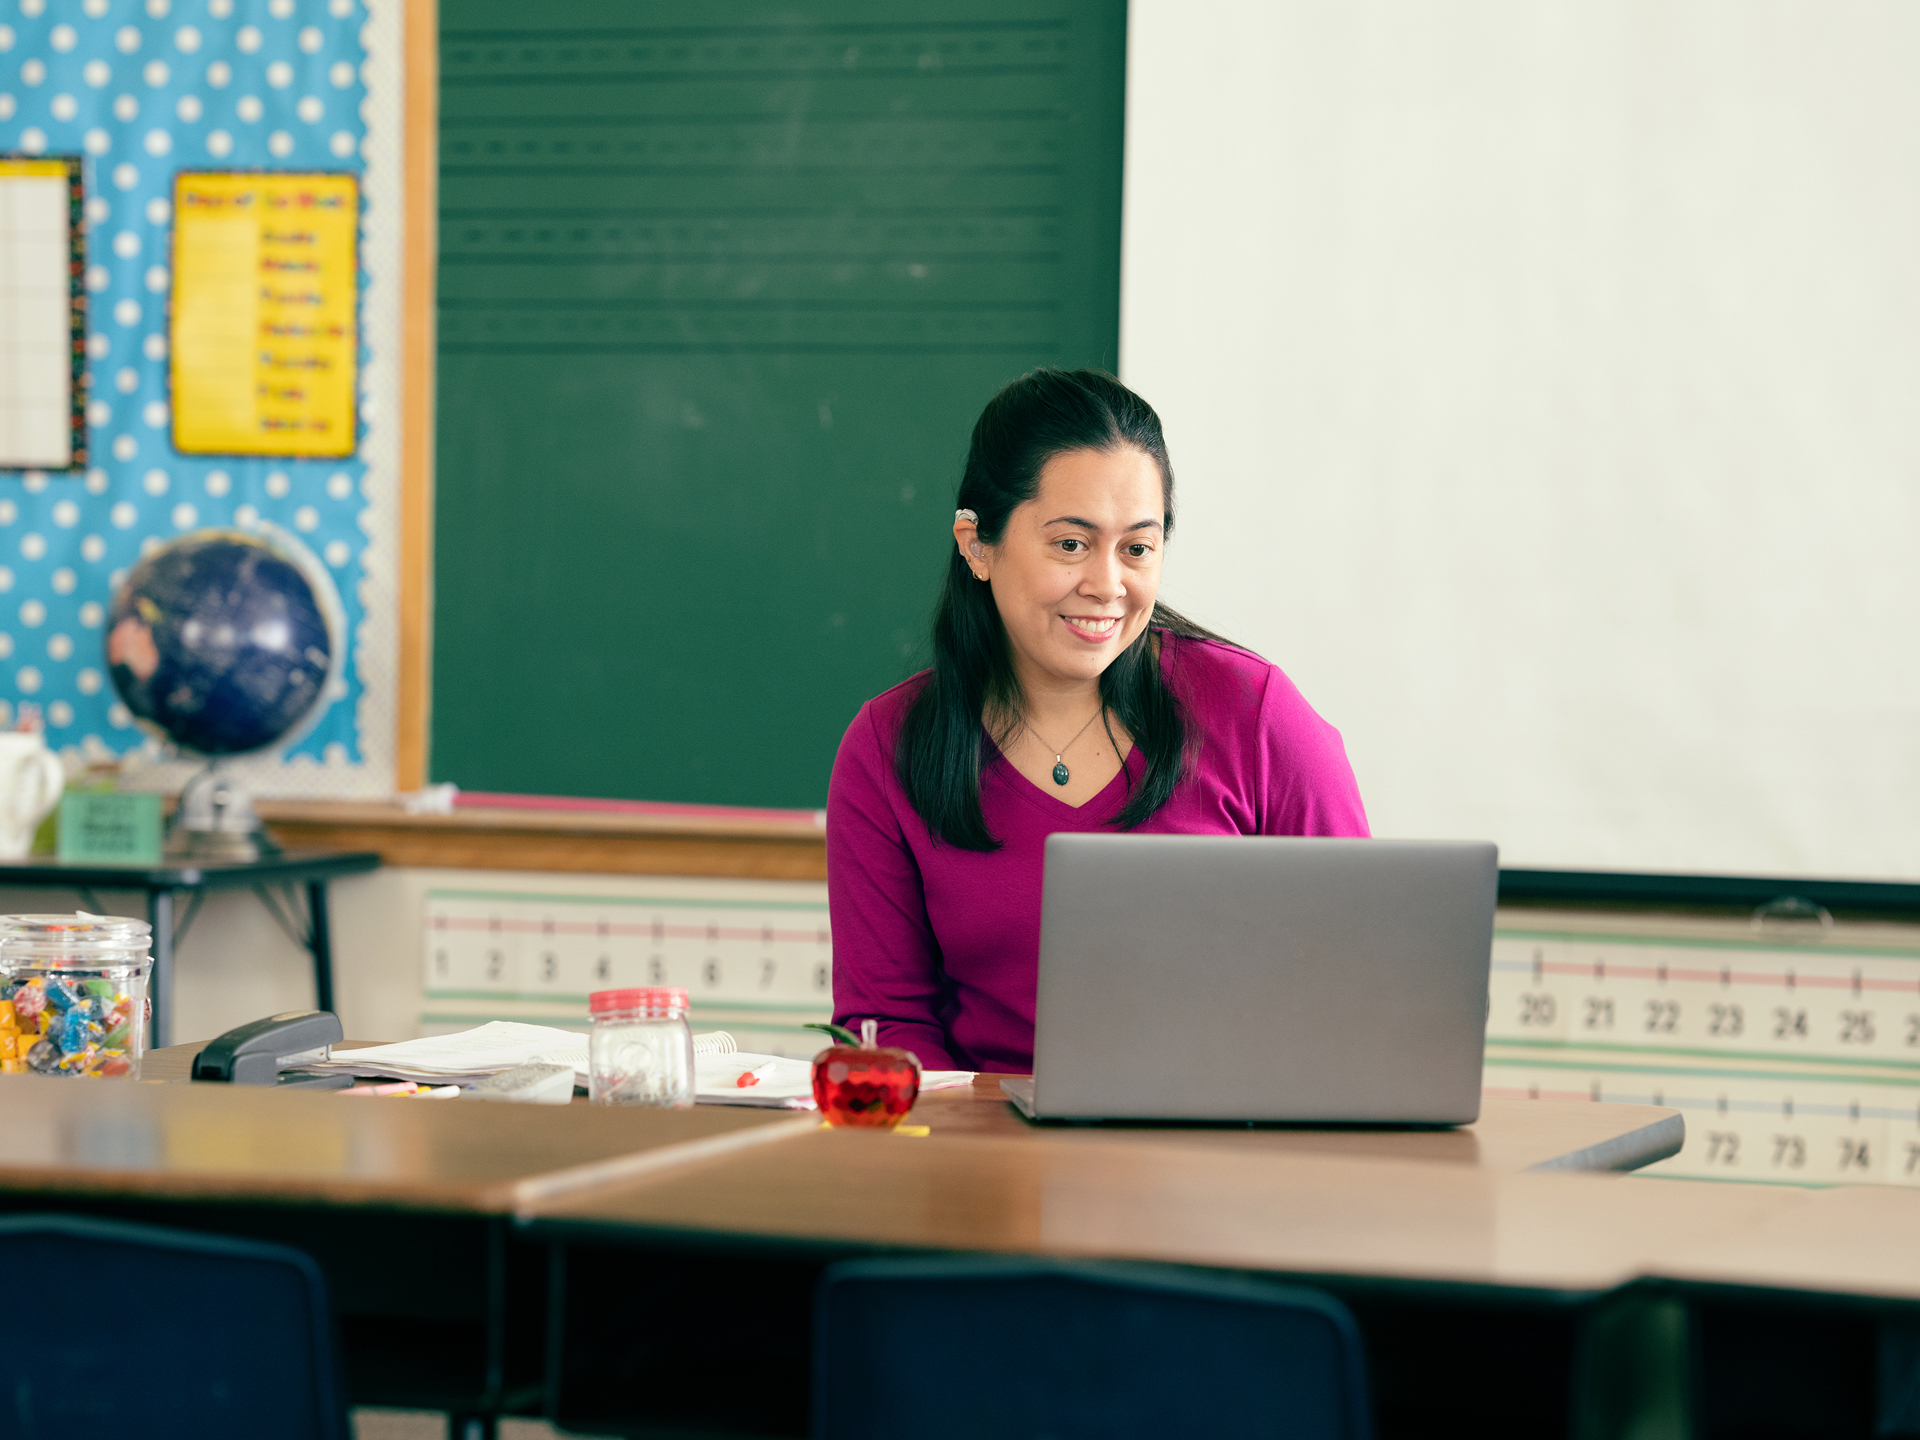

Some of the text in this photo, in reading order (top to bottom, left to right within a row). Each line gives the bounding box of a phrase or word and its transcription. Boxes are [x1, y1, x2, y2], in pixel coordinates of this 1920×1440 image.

[487, 949, 504, 979] 2
[541, 952, 557, 982] 3
[760, 959, 777, 987] 7
[1519, 993, 1920, 1047] 20 21 22 23 24 25 2
[1706, 1132, 1920, 1174] 72 73 74 7
